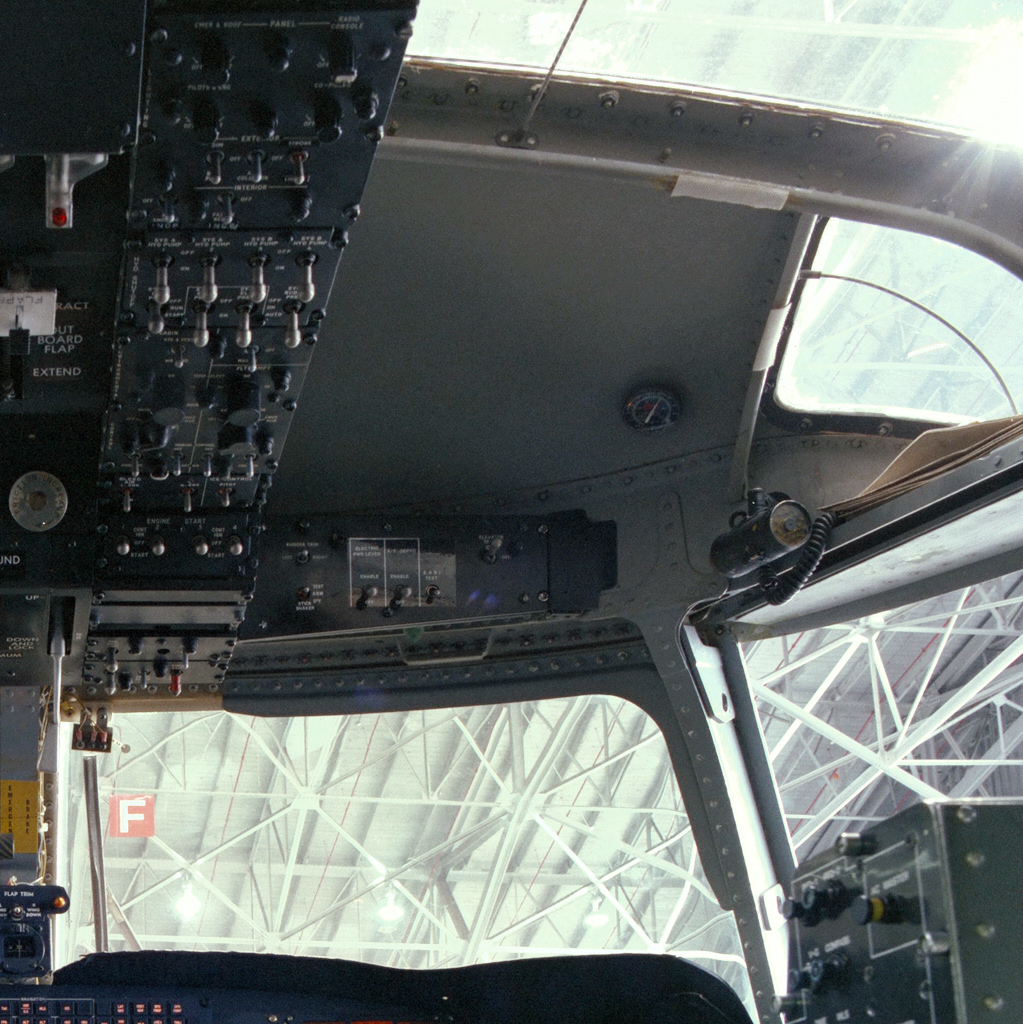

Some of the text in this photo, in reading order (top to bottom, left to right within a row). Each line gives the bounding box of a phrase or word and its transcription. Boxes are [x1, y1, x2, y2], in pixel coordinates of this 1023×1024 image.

[37, 335, 83, 345] BOARD
[43, 345, 75, 354] FLAP
[32, 366, 82, 377] EXTEND
[119, 799, 147, 834] F
